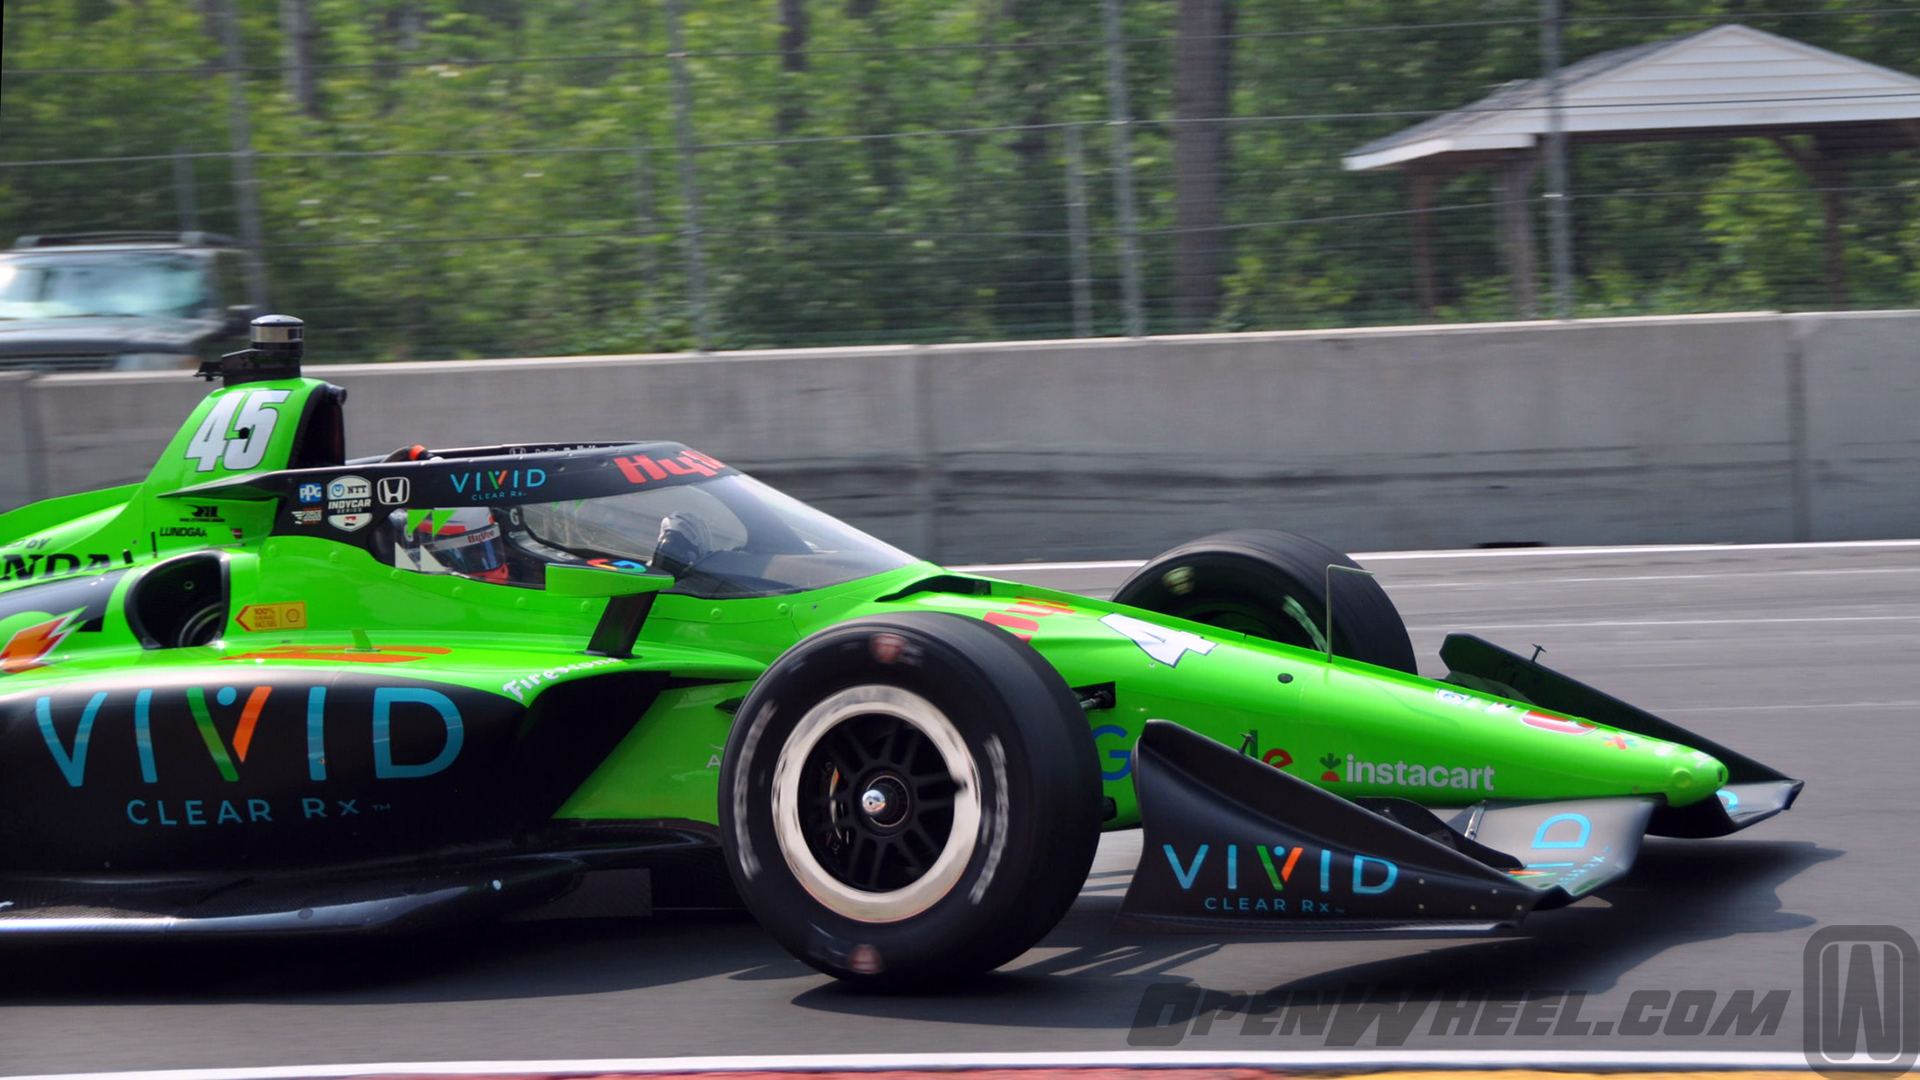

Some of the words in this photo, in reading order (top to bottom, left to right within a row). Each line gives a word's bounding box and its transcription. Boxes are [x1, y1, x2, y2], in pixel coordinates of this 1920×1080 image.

[184, 389, 293, 473] 45
[300, 484, 322, 501] PPG
[347, 485, 367, 495] NTT
[450, 468, 547, 493] VIVID
[328, 498, 371, 510] INDYCAR
[471, 491, 506, 501] CLEAR
[36, 686, 464, 787] VIVID
[1346, 753, 1496, 791] instacart
[126, 799, 273, 825] CLEAR
[1163, 844, 1398, 894] VIVID
[1204, 897, 1287, 912] CLEAR
